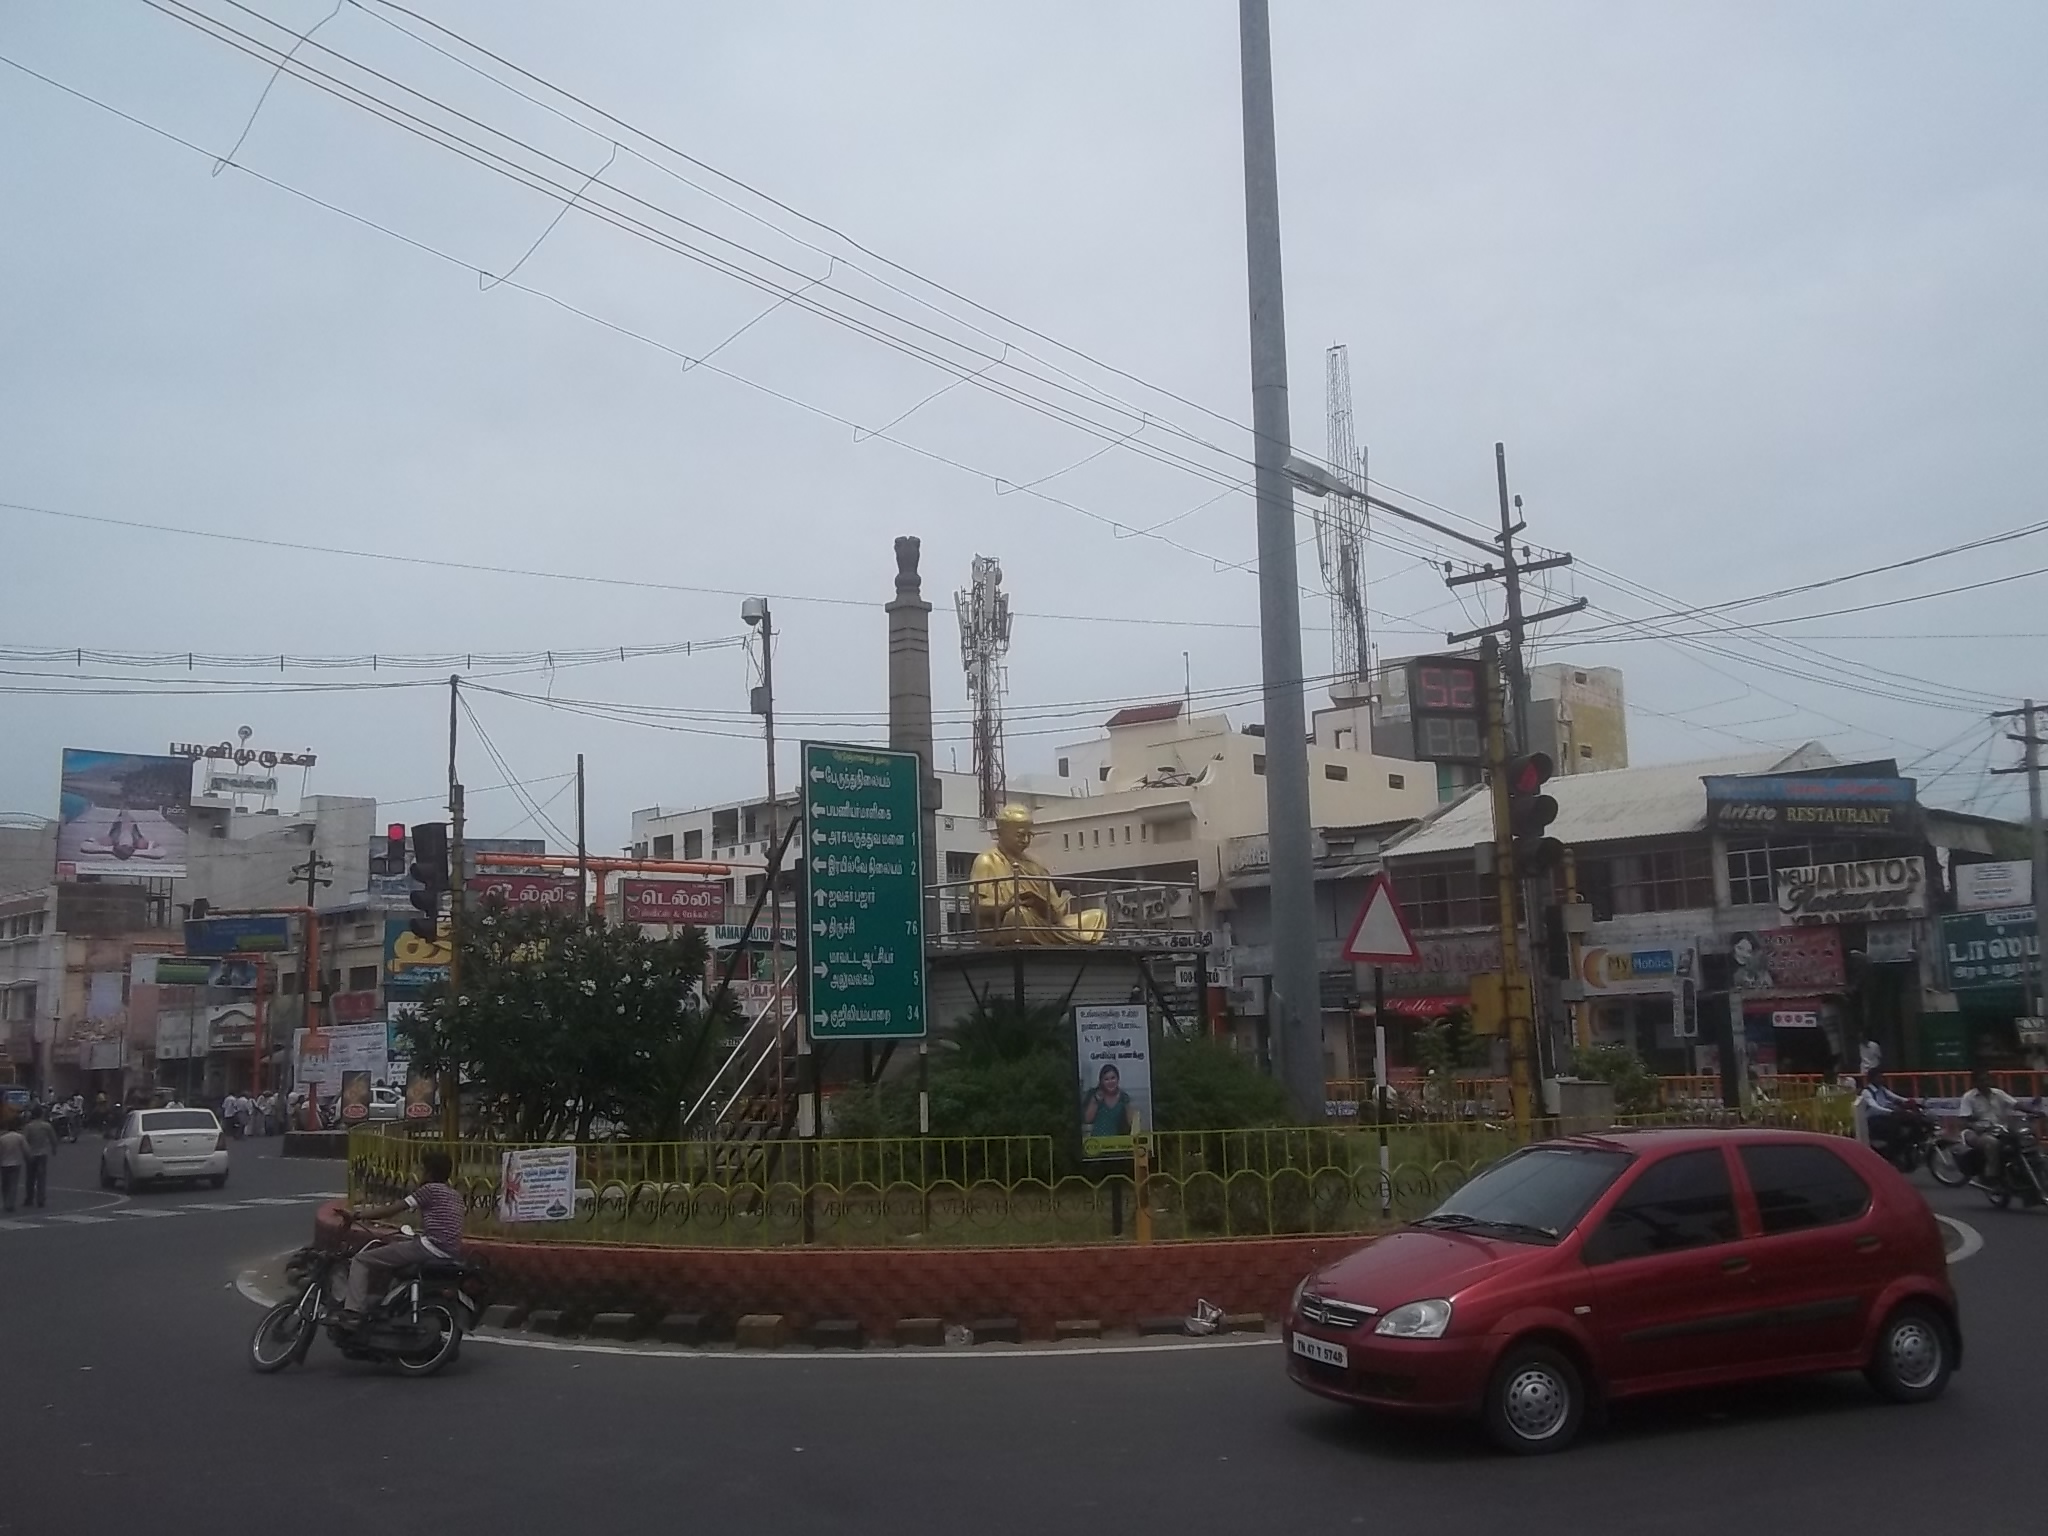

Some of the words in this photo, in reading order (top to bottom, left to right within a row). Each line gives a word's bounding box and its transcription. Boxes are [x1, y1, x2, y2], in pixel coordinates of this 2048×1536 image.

[1420, 668, 1475, 708] 52
[169, 741, 317, 769] பழனிமுருகன்
[1718, 803, 1778, 821] Aristo
[1787, 806, 1892, 824] RESTAURANT
[911, 831, 916, 846] 1
[910, 860, 917, 876] 2
[1776, 868, 1817, 888] NEW
[1818, 857, 1921, 891] ARISTOS
[641, 889, 711, 906] டெல்லி
[904, 920, 918, 936] 76
[1607, 956, 1630, 973] My
[913, 970, 920, 986] 5
[906, 1005, 920, 1021] 34
[1297, 1340, 1306, 1353] TN
[1308, 1344, 1315, 1356] 47
